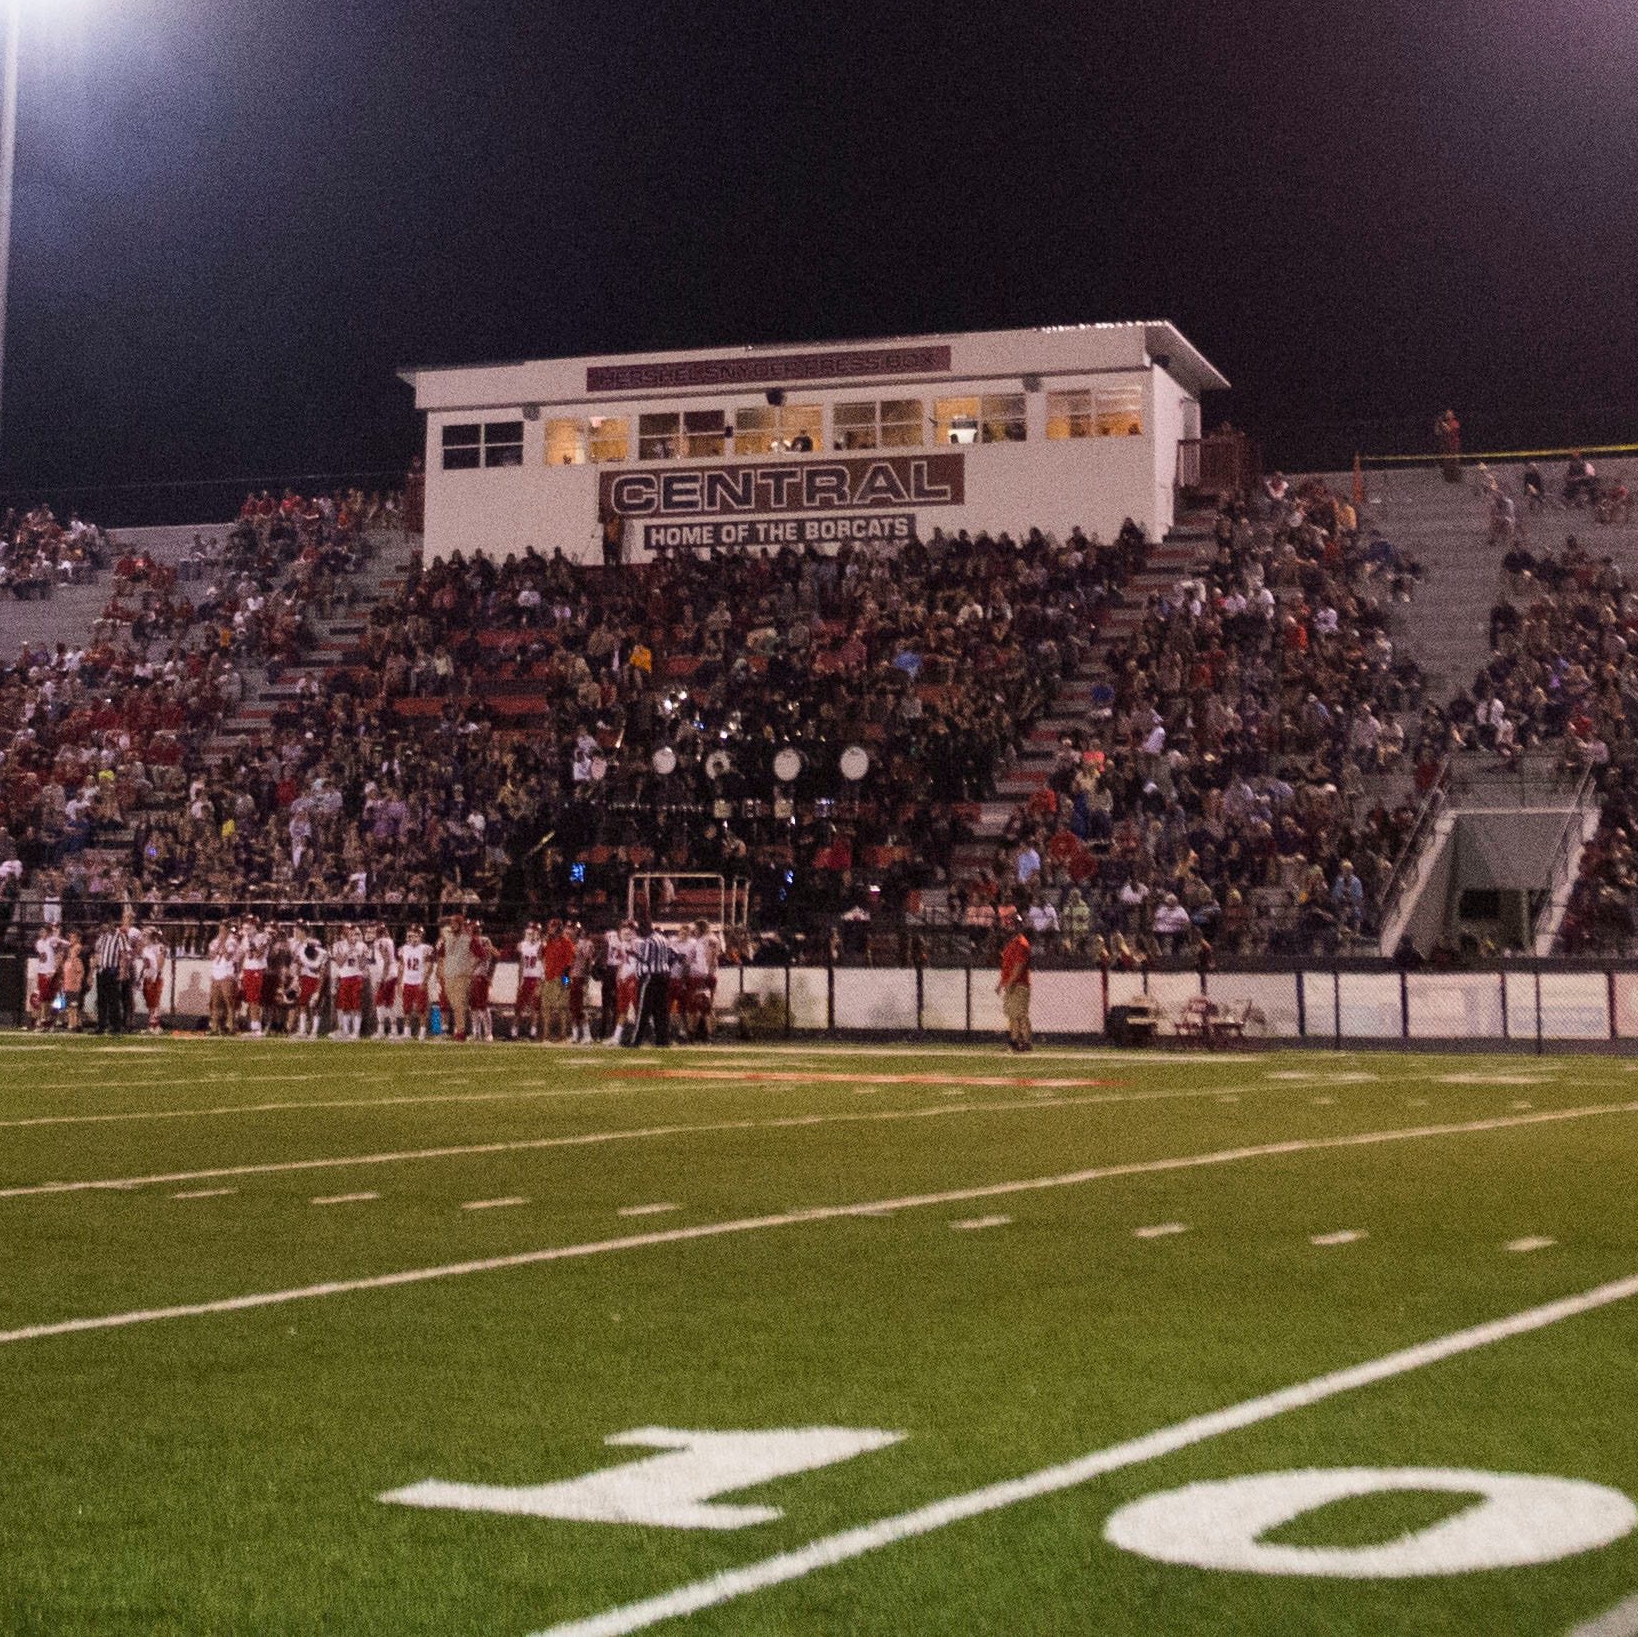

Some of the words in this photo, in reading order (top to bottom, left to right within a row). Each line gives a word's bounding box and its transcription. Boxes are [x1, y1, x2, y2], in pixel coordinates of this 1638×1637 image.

[885, 352, 934, 370] BOX
[613, 462, 951, 513] CENTRAL
[651, 526, 713, 548] HOME
[721, 524, 749, 543] OF
[756, 521, 799, 542] THE
[805, 517, 909, 540] BOBCATS
